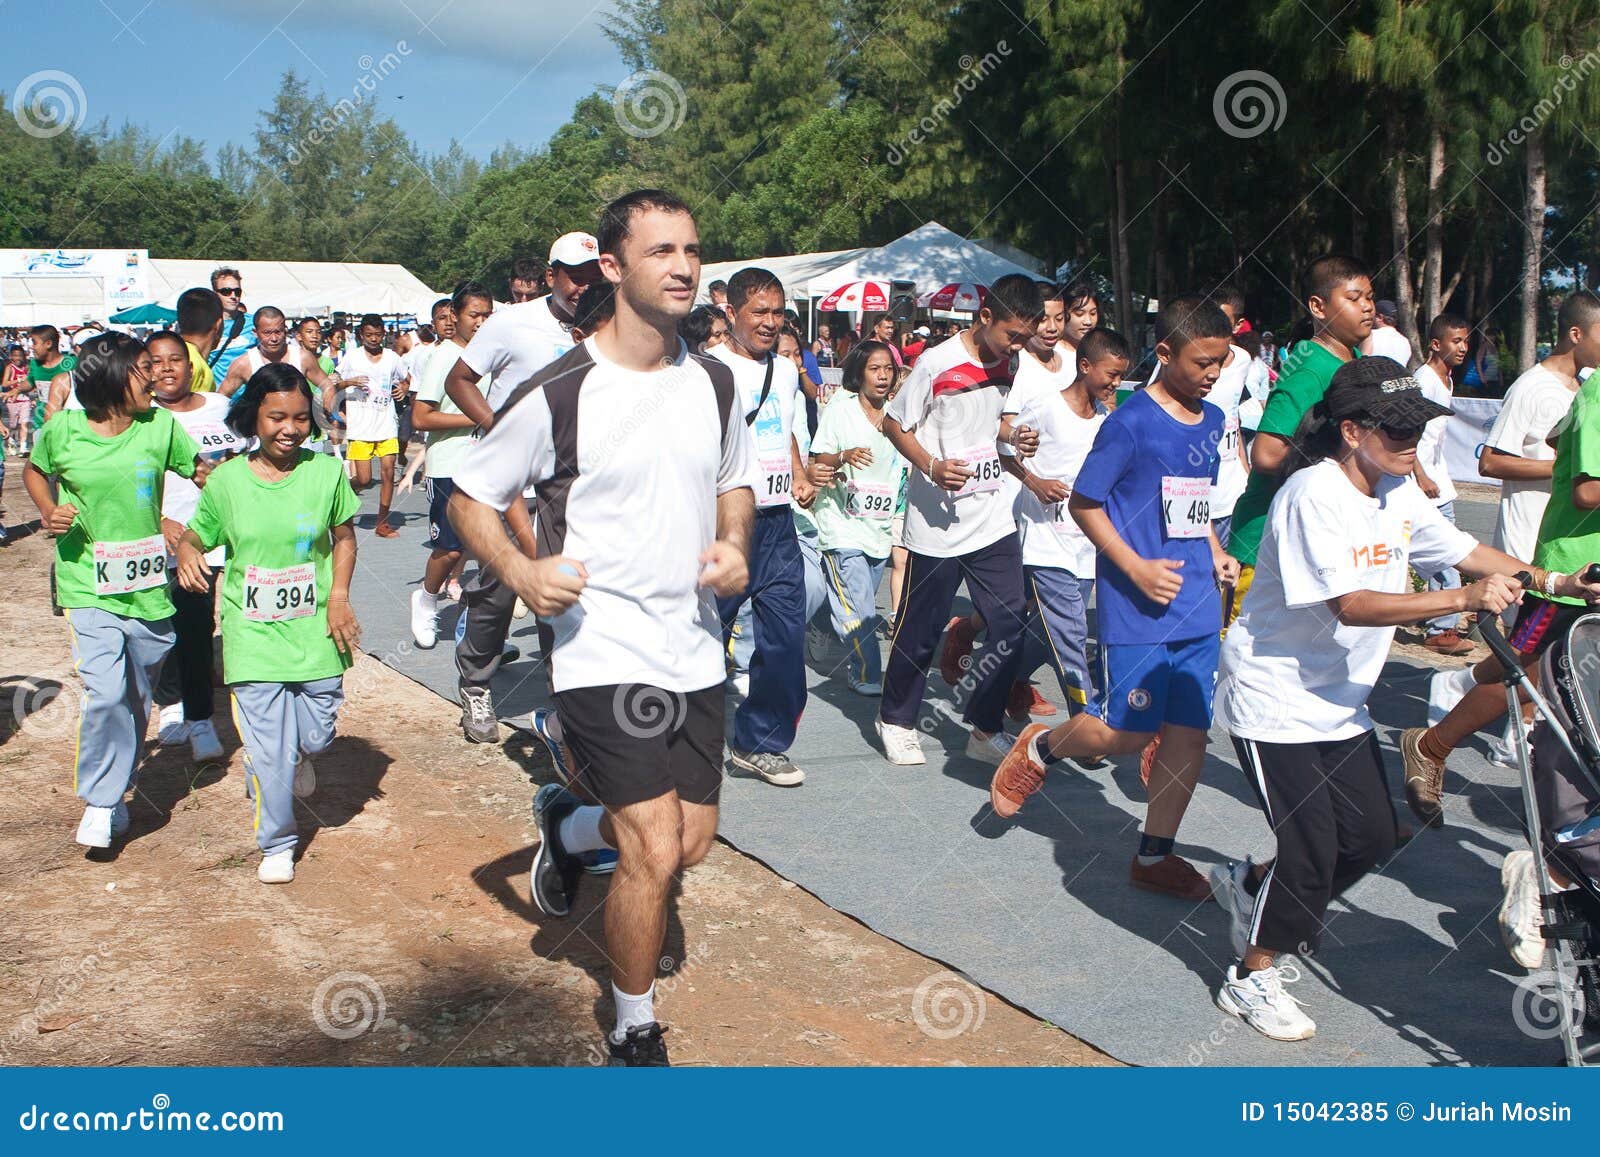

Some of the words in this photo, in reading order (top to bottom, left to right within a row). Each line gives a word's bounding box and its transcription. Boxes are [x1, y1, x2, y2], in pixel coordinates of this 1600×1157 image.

[202, 433, 236, 447] 488
[973, 459, 1000, 482] 465
[767, 473, 790, 495] 180
[846, 493, 856, 509] K
[864, 495, 892, 512] 392
[1055, 503, 1065, 522] K
[1164, 499, 1172, 524] K
[1187, 500, 1210, 525] 499
[96, 561, 110, 583] K
[126, 555, 166, 582] 393
[246, 585, 260, 609] K
[276, 583, 316, 610] 394
